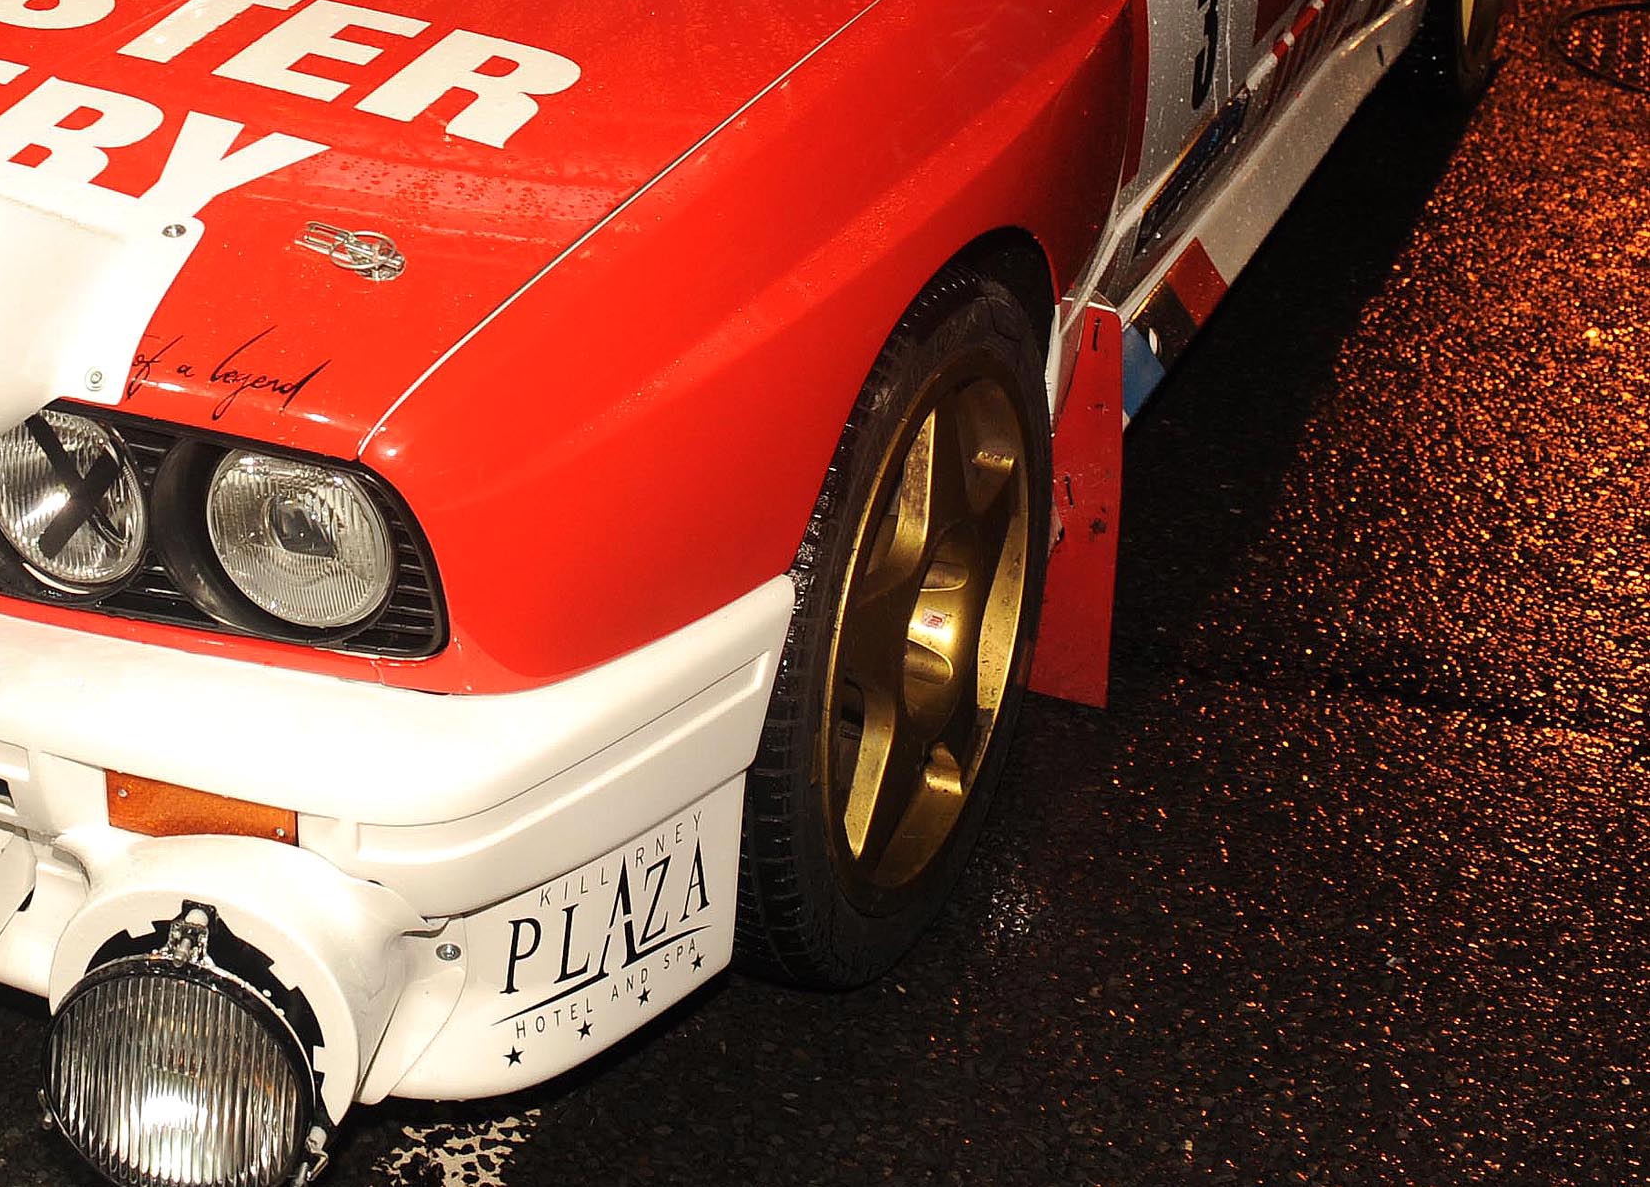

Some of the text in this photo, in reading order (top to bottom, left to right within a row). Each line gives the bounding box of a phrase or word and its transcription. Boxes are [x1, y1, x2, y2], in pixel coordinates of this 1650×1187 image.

[176, 364, 196, 378] a
[210, 324, 333, 422] legend
[499, 836, 711, 996] PLAZA
[515, 937, 696, 1040] HOTEL AND SPA
